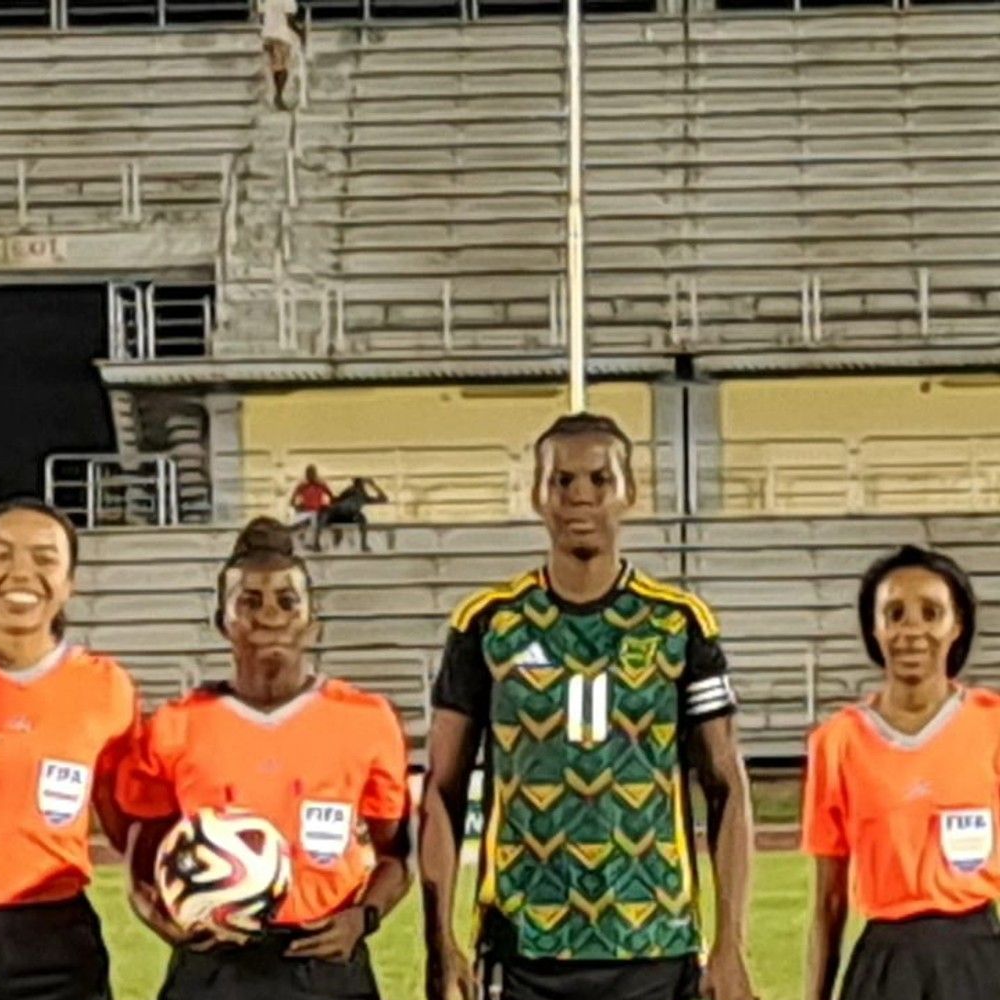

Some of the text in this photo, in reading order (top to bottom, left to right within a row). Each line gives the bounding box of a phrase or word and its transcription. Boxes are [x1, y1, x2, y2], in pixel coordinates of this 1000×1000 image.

[567, 672, 607, 742] 11
[46, 764, 82, 784] FIFA
[305, 807, 344, 823] FIFA
[946, 814, 986, 831] FIFA
